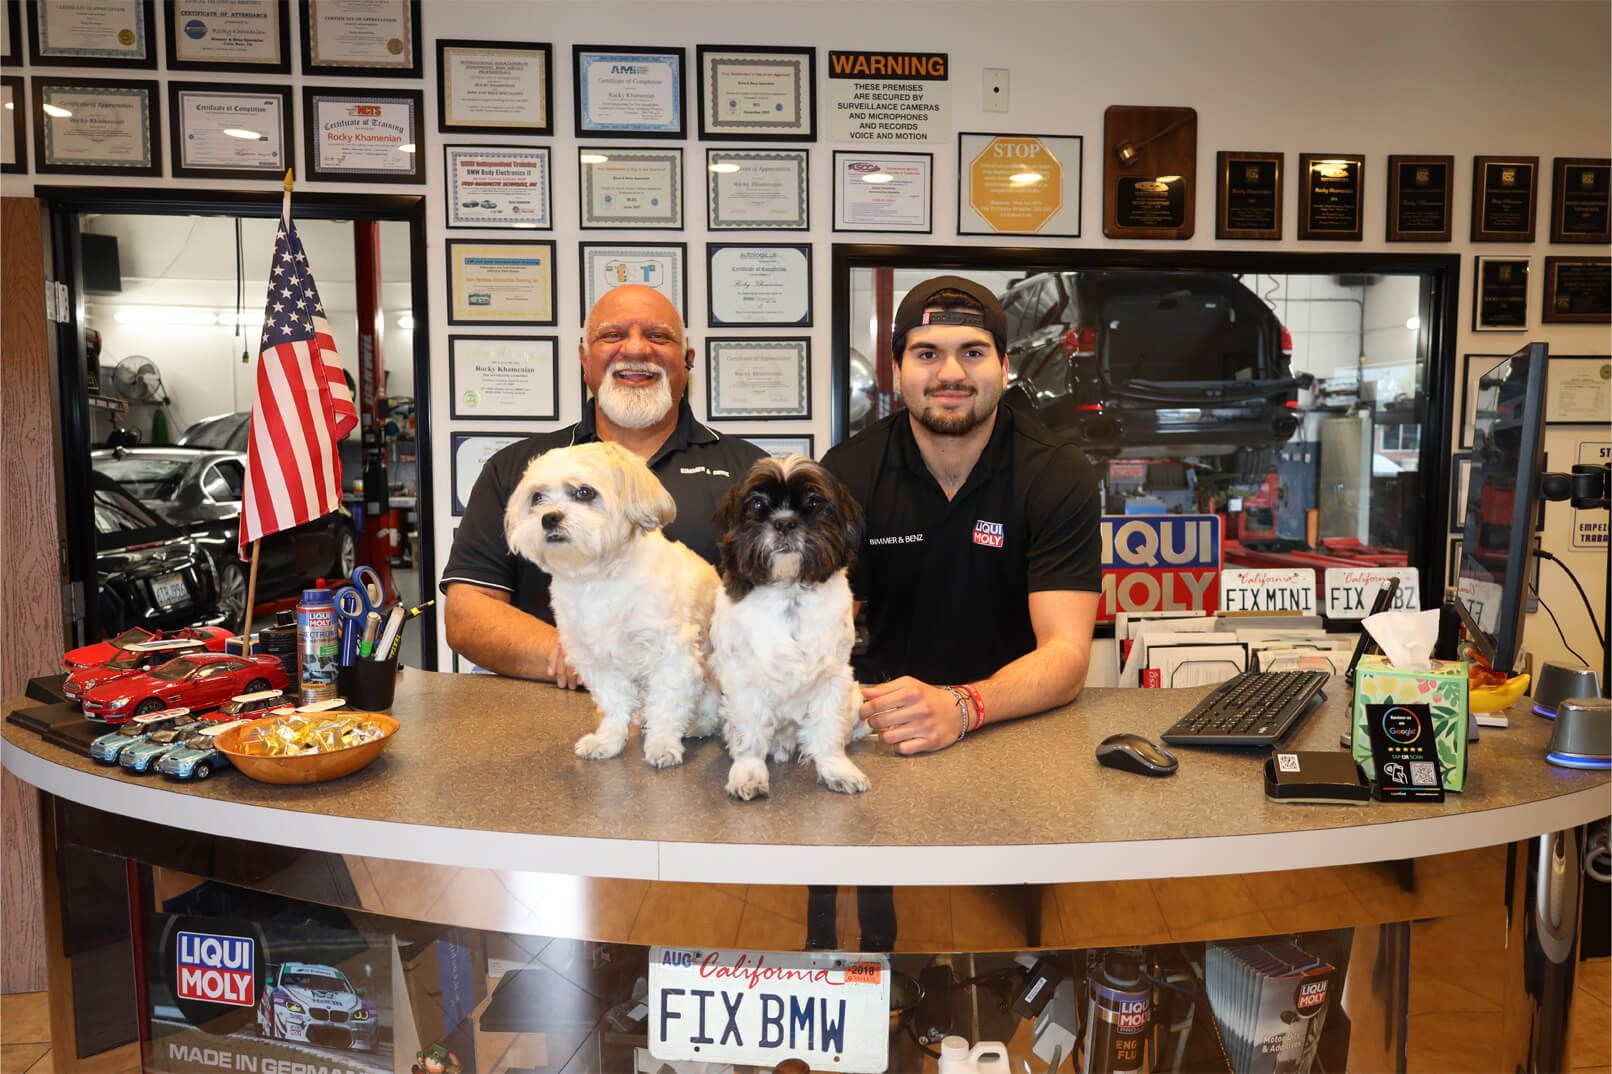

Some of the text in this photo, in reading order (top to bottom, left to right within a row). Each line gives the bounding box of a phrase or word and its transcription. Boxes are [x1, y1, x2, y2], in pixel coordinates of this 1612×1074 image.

[832, 55, 944, 76] WARNING
[854, 83, 924, 92] THESE PREMISES
[872, 93, 911, 101] SECURED
[837, 102, 898, 110] SURVEILLANCE
[868, 113, 928, 121] MICROPHONES
[324, 119, 360, 131] Certificate
[372, 118, 404, 133] Training
[859, 122, 877, 130] AND
[327, 132, 402, 143] Rocky Khamenian
[876, 132, 893, 140] AND
[993, 143, 1040, 158] STOP
[975, 522, 1002, 535] LIQUI
[869, 533, 924, 545] BIMMER & BENZ
[974, 532, 1002, 546] MOLY
[1101, 520, 1212, 567] IQUI
[1240, 573, 1296, 587] California
[1343, 572, 1390, 586] Californ
[1226, 588, 1311, 611] FIX MINI
[1331, 587, 1365, 610] FIX
[1389, 727, 1416, 736] Google
[181, 935, 249, 970] LIQUI
[662, 951, 845, 989] AUG California
[851, 965, 874, 976] 2018
[181, 968, 252, 1001] MOLY
[1302, 981, 1327, 995] LIQUI
[1300, 992, 1325, 1005] MOLY
[1121, 1001, 1149, 1014] LIQU
[660, 988, 846, 1053] FIX BMW
[1261, 1044, 1268, 1053] &
[169, 1043, 232, 1068] MADE
[236, 1053, 258, 1073] IN
